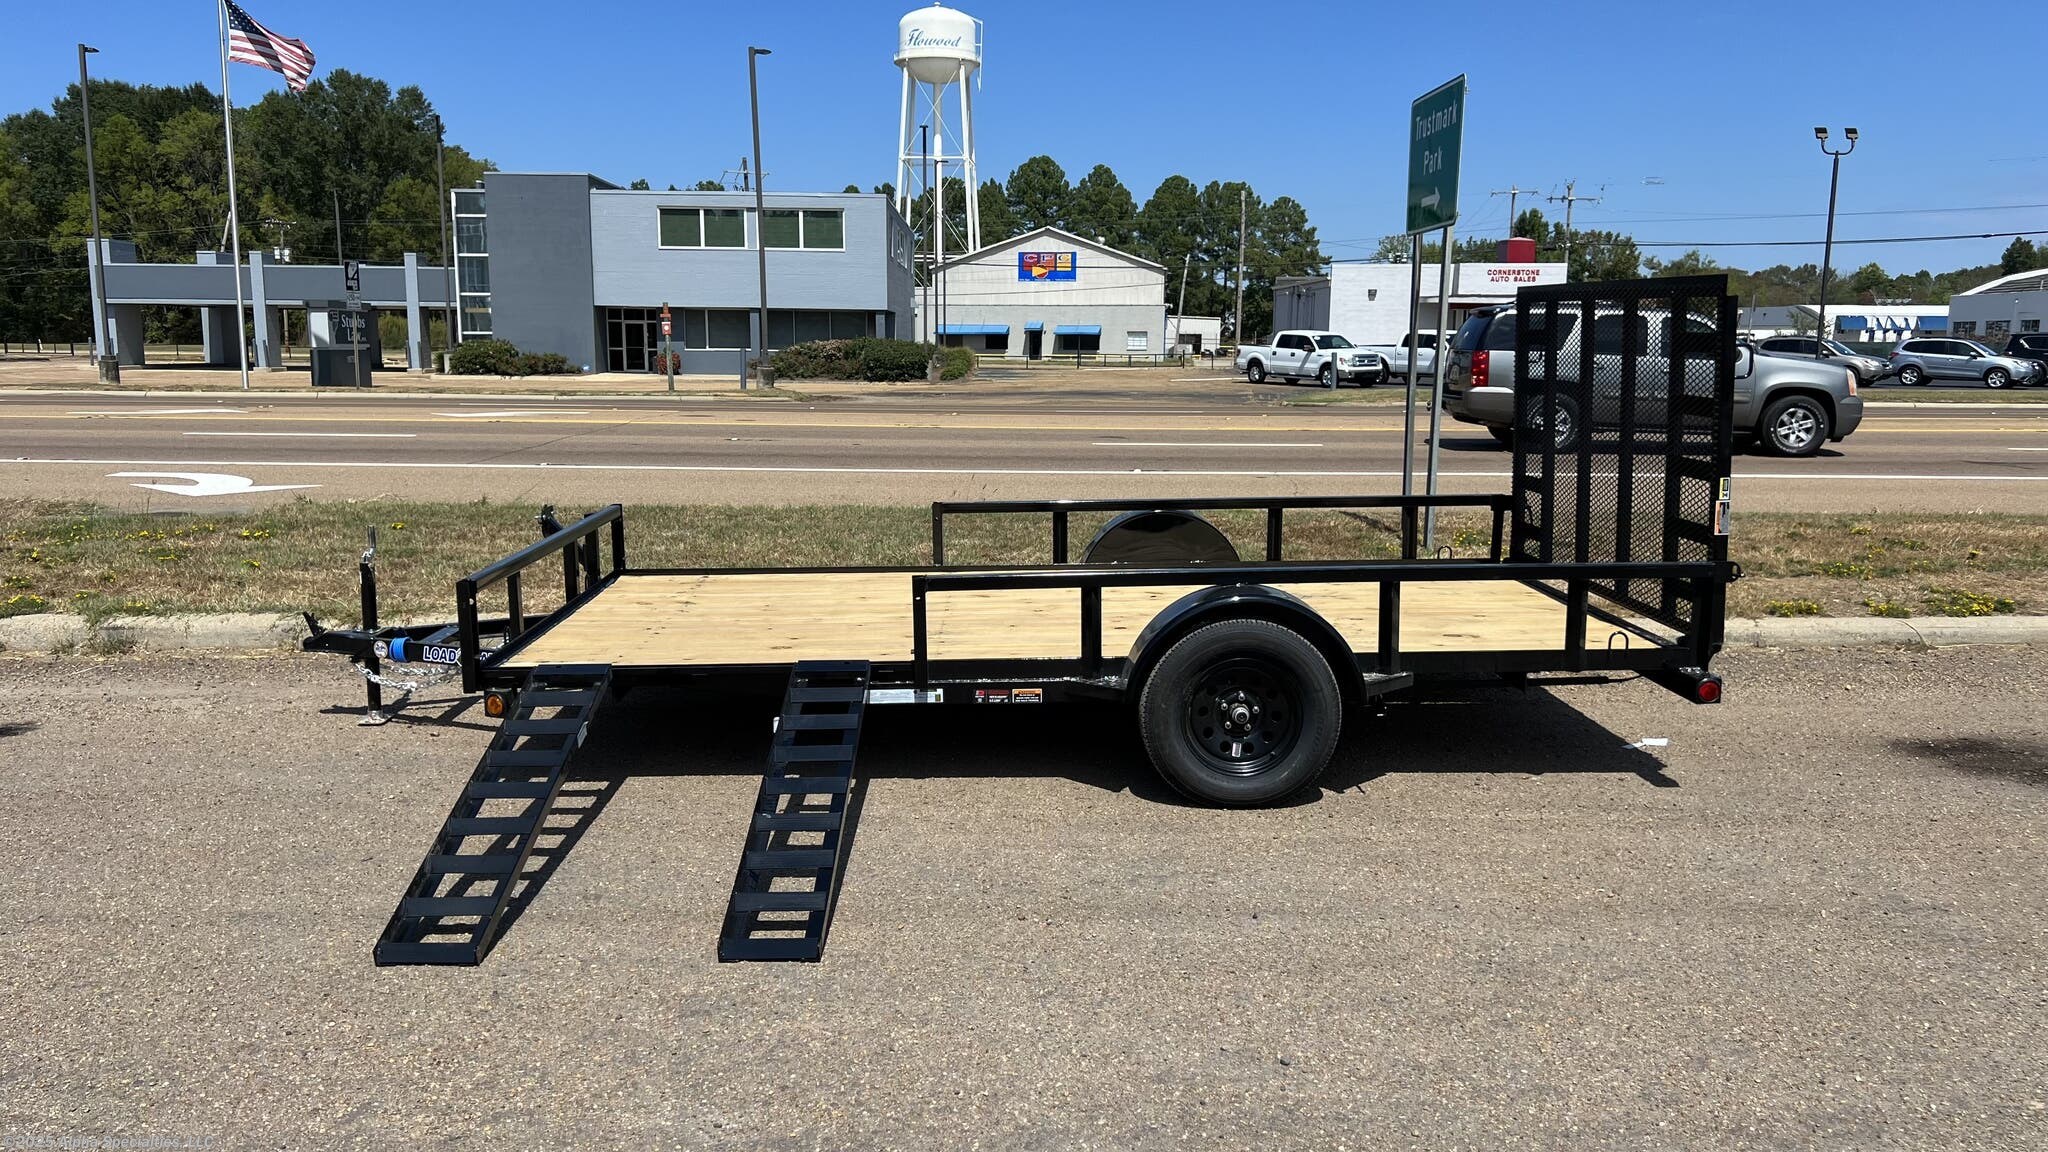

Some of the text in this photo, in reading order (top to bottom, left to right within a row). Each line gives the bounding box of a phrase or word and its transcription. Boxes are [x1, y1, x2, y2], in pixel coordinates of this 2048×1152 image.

[905, 28, 962, 47] Flowood
[1415, 102, 1458, 142] Trustmark
[1423, 146, 1443, 176] Park
[341, 314, 366, 328] Stubs
[424, 646, 458, 662] LOAD
